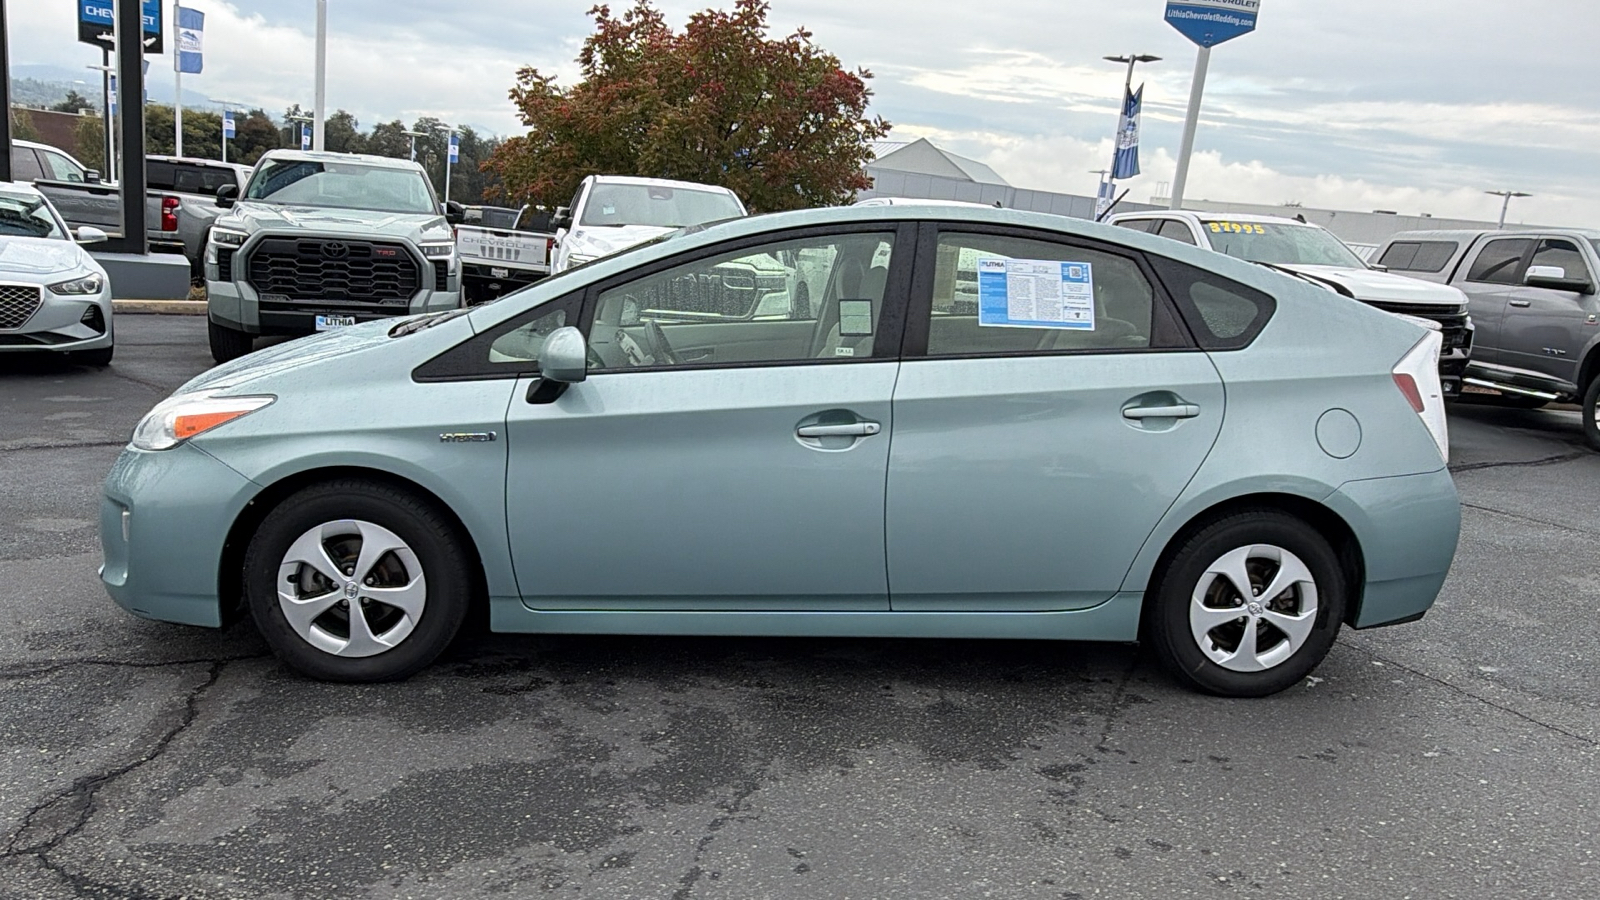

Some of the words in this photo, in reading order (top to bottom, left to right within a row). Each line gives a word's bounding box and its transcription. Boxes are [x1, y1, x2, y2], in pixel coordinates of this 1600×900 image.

[1209, 0, 1257, 8] EVROLET
[85, 5, 156, 26] CHEVET
[1167, 10, 1254, 26] LithiaChevroletRedding.com
[463, 237, 540, 250] CHEVROLET
[376, 249, 396, 257] TRD
[326, 317, 354, 326] LITHIA
[439, 432, 488, 443] HYBRID
